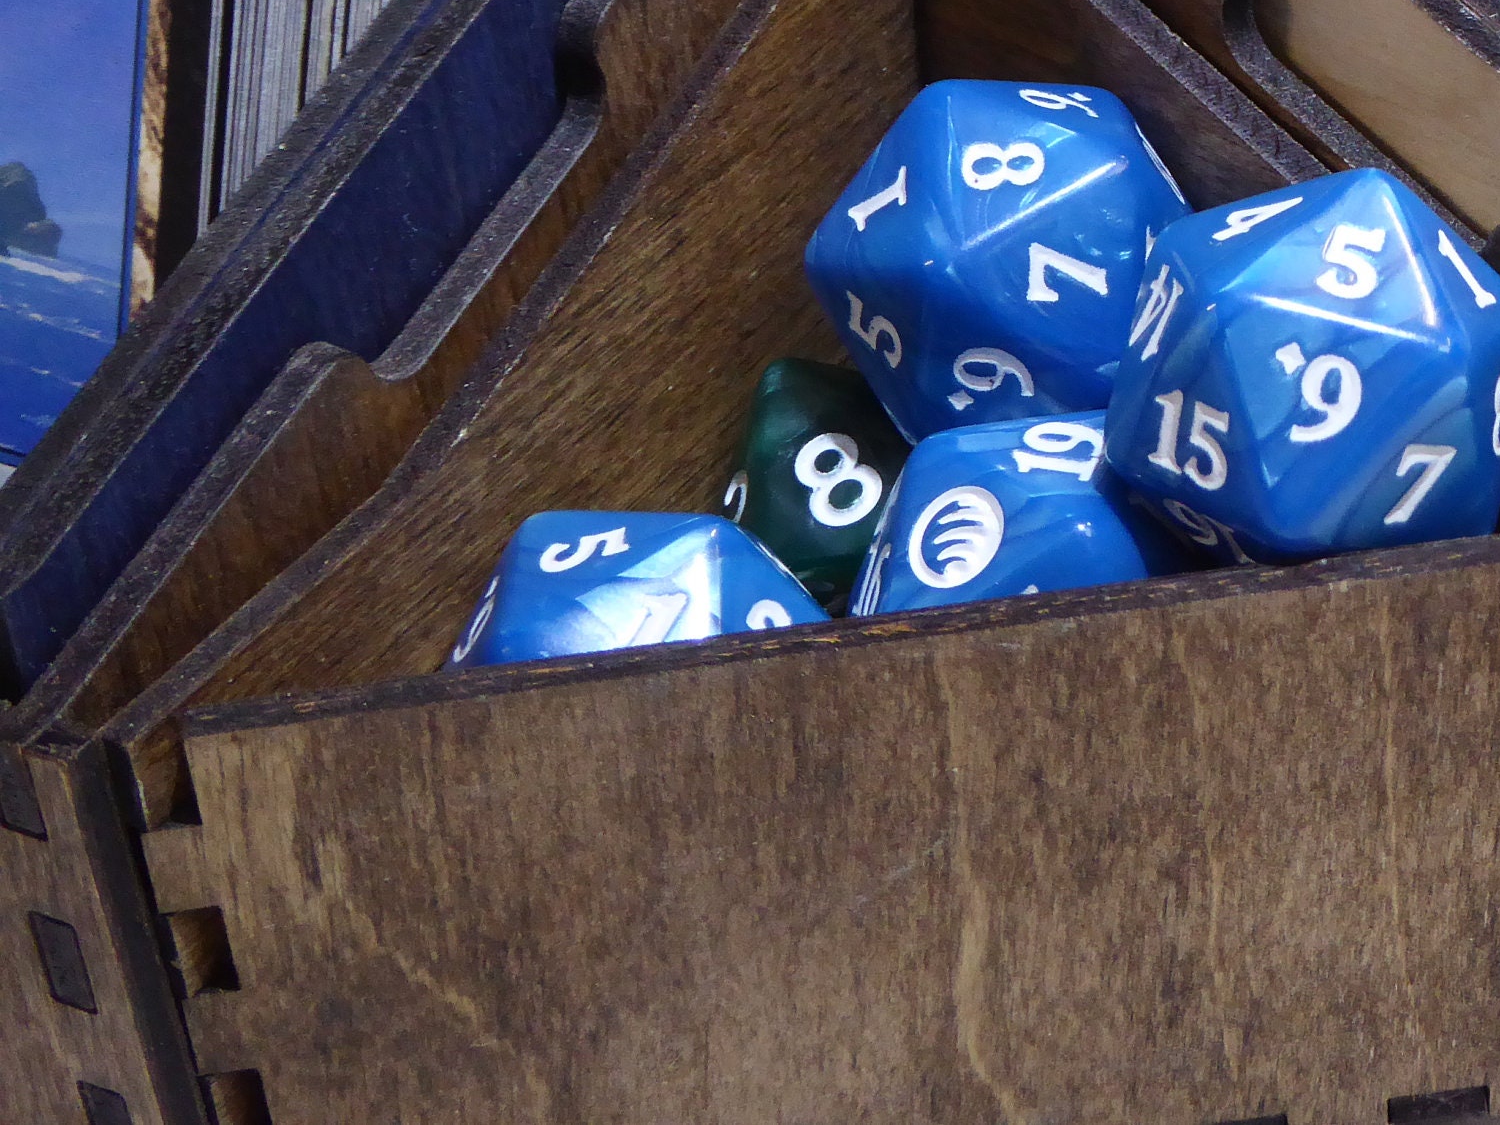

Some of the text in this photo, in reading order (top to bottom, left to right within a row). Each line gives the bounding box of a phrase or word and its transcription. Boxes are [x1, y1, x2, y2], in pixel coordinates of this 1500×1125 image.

[847, 166, 907, 231] 1
[961, 141, 1045, 191] 8
[1212, 197, 1303, 242] 4
[1026, 242, 1108, 302] 7
[1316, 224, 1386, 299] 5
[1438, 228, 1496, 308] 1
[847, 291, 902, 369] 5
[1011, 421, 1105, 482] 19
[1147, 389, 1230, 491] 15
[794, 432, 882, 527] 8
[1383, 445, 1456, 524] 7
[538, 526, 630, 574] 5
